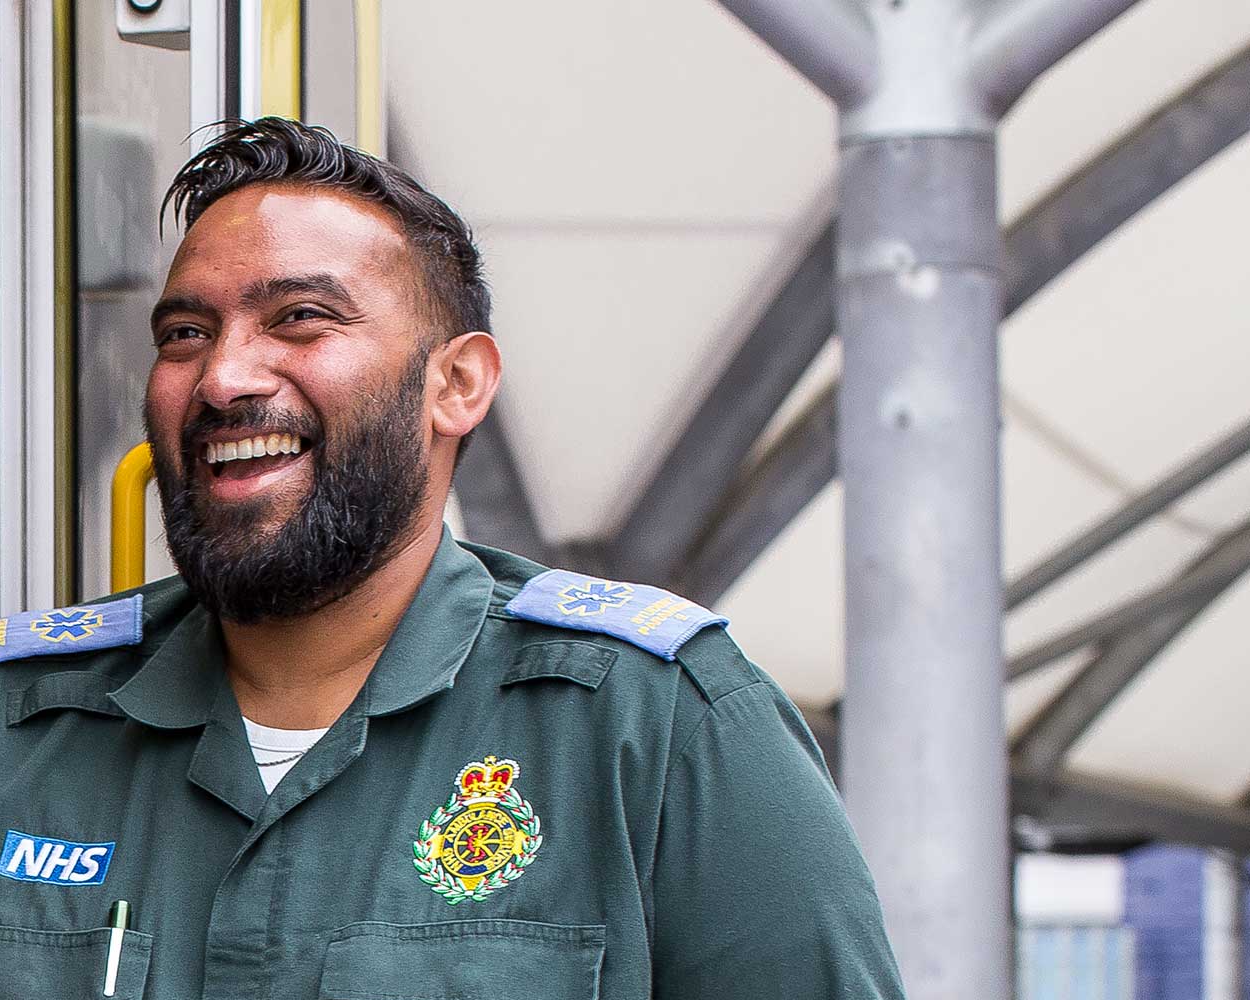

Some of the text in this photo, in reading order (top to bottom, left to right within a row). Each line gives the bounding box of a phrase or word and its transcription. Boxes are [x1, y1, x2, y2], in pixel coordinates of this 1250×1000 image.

[6, 839, 108, 882] NHS
[445, 811, 508, 843] AMBULANCE
[486, 828, 516, 871] SERVICE
